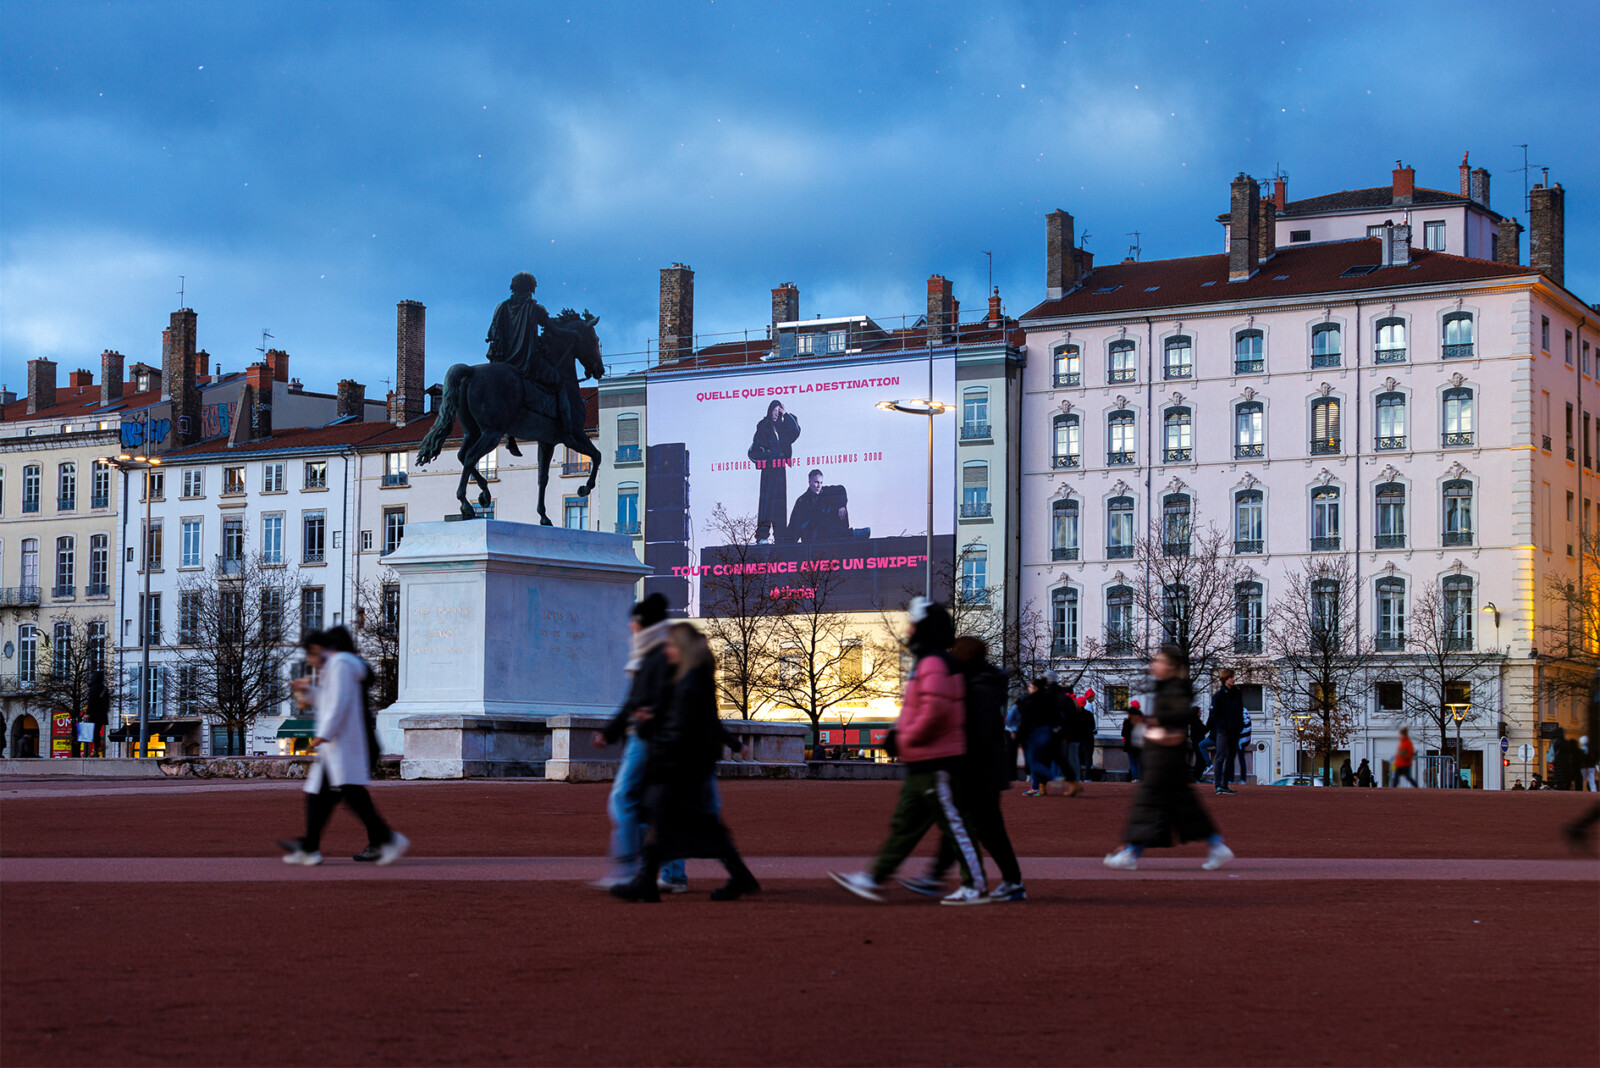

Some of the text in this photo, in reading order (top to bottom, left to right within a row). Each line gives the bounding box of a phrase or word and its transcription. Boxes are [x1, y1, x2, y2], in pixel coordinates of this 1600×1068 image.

[696, 376, 900, 403] QUELLE QUE SOIT LA DESTINATION
[711, 451, 883, 472] L'HISTOIRE DU GROUPE BRUTALISMUS 3000
[671, 564, 711, 577] TOUT
[713, 561, 798, 576] COMMENCE
[800, 559, 840, 572] AVEC
[842, 558, 864, 570] UN
